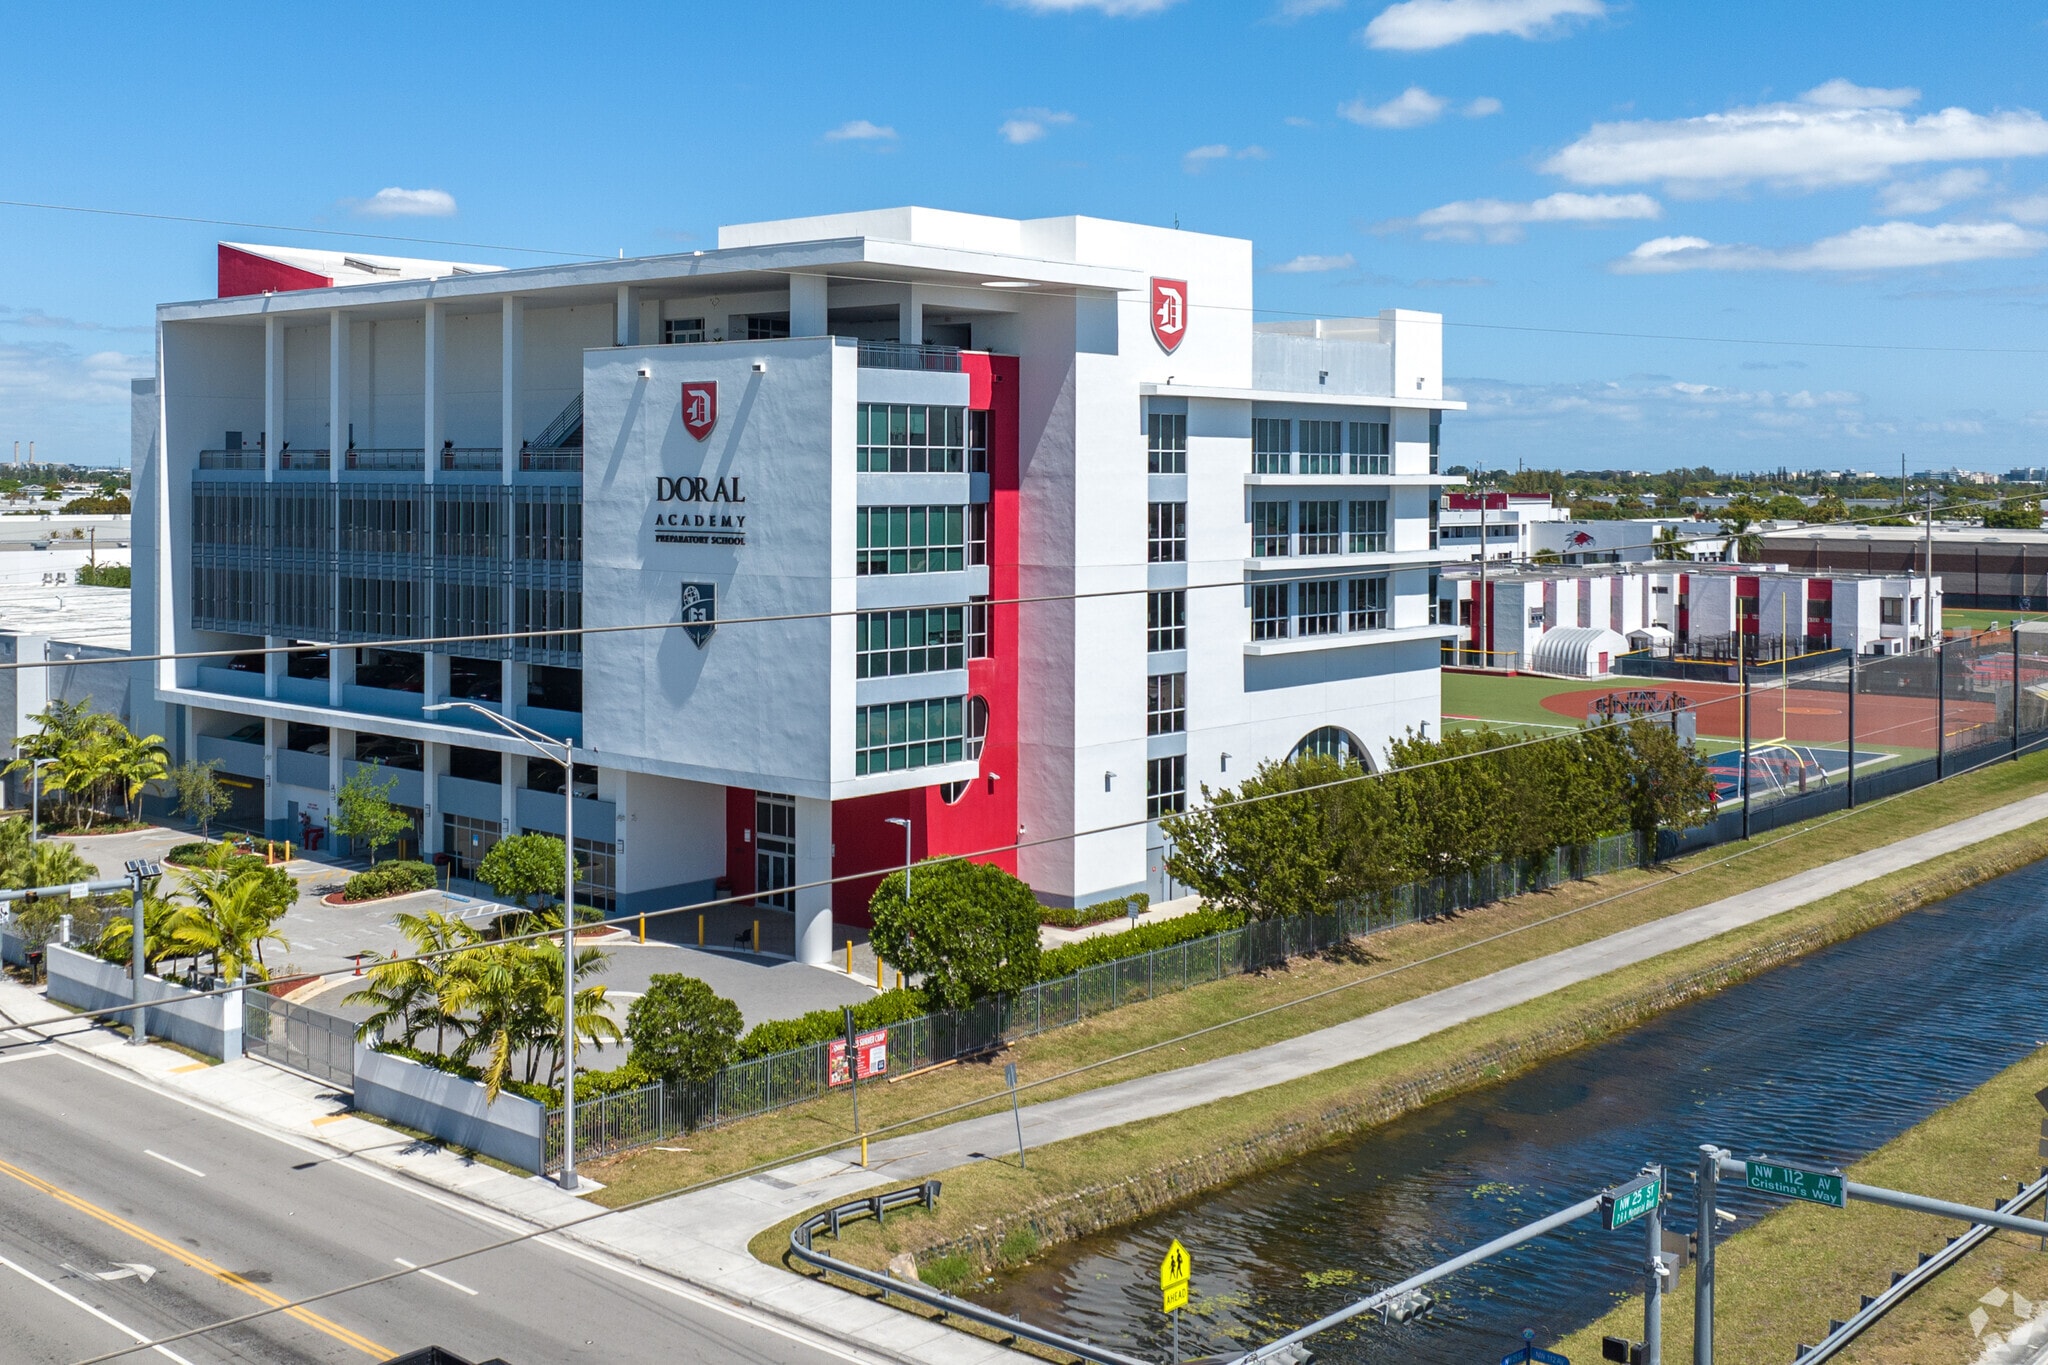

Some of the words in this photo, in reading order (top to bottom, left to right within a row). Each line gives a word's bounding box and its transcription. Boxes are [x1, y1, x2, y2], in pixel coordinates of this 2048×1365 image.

[656, 476, 746, 503] DORAL
[655, 513, 746, 528] ACADEMY
[655, 534, 710, 544] PREPARATORY
[710, 536, 746, 546] SCHOOL
[1755, 1165, 1773, 1179] NW
[1783, 1169, 1804, 1186] 112
[1818, 1177, 1831, 1190] AV
[1619, 1195, 1630, 1212] NW
[1631, 1189, 1642, 1206] 25
[1646, 1184, 1655, 1198] ST
[1751, 1177, 1807, 1196] Cristina's
[1812, 1189, 1837, 1204] Way
[1166, 1288, 1186, 1304] AHEAD
